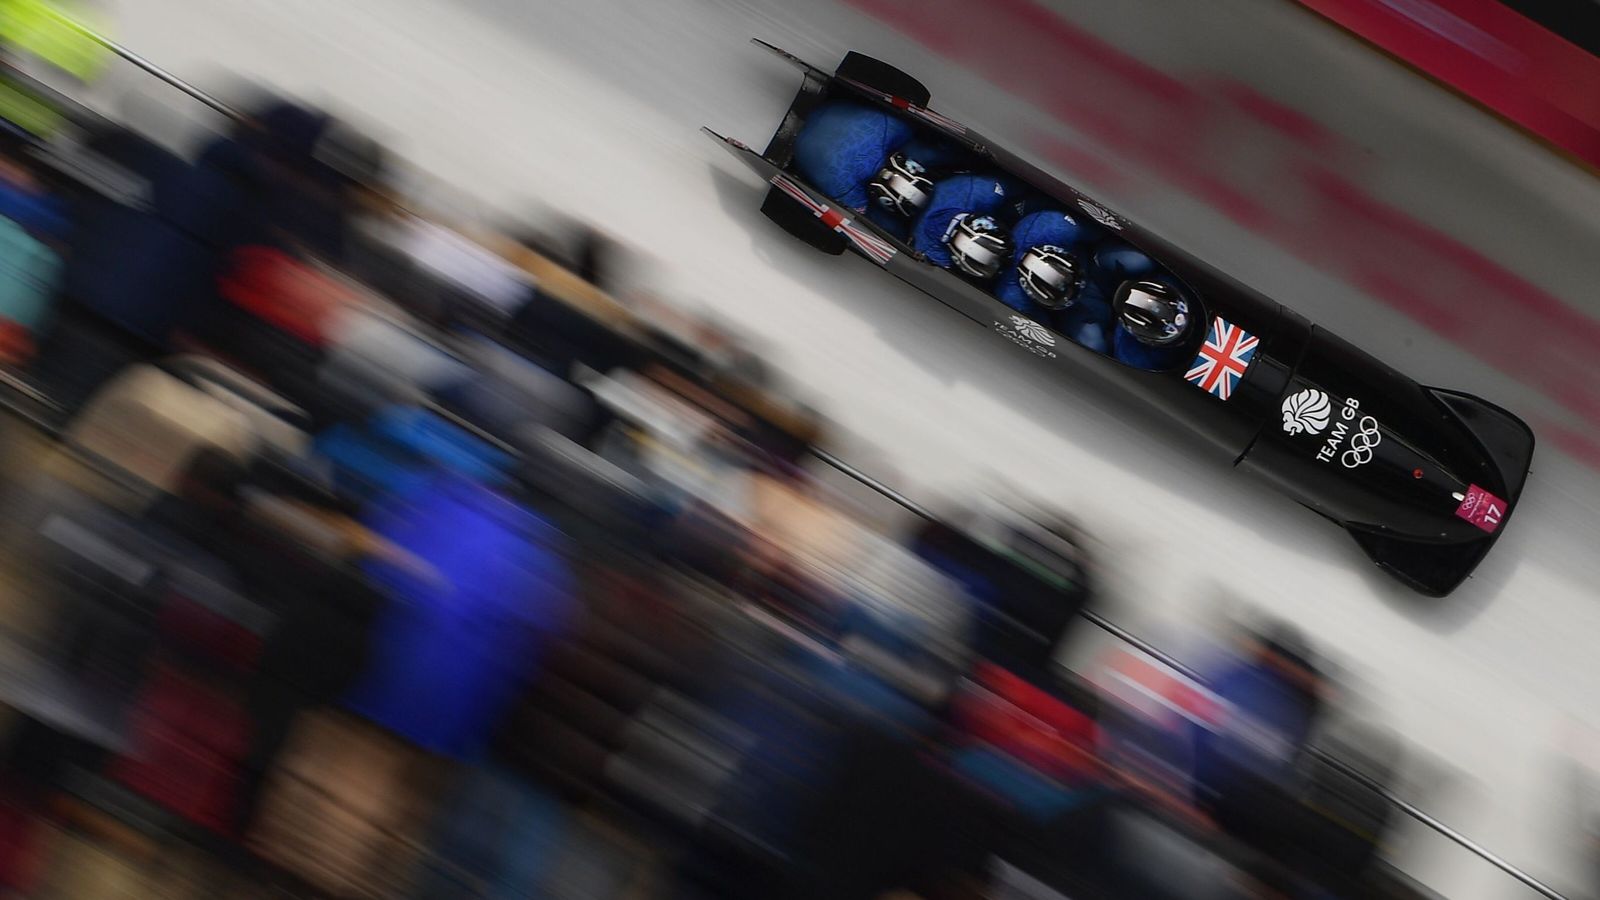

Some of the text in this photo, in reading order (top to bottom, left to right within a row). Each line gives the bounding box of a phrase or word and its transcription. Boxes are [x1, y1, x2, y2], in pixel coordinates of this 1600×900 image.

[994, 320, 1032, 344] TEAM
[1316, 397, 1360, 463] TEAM GB
[1484, 503, 1502, 524] 17
